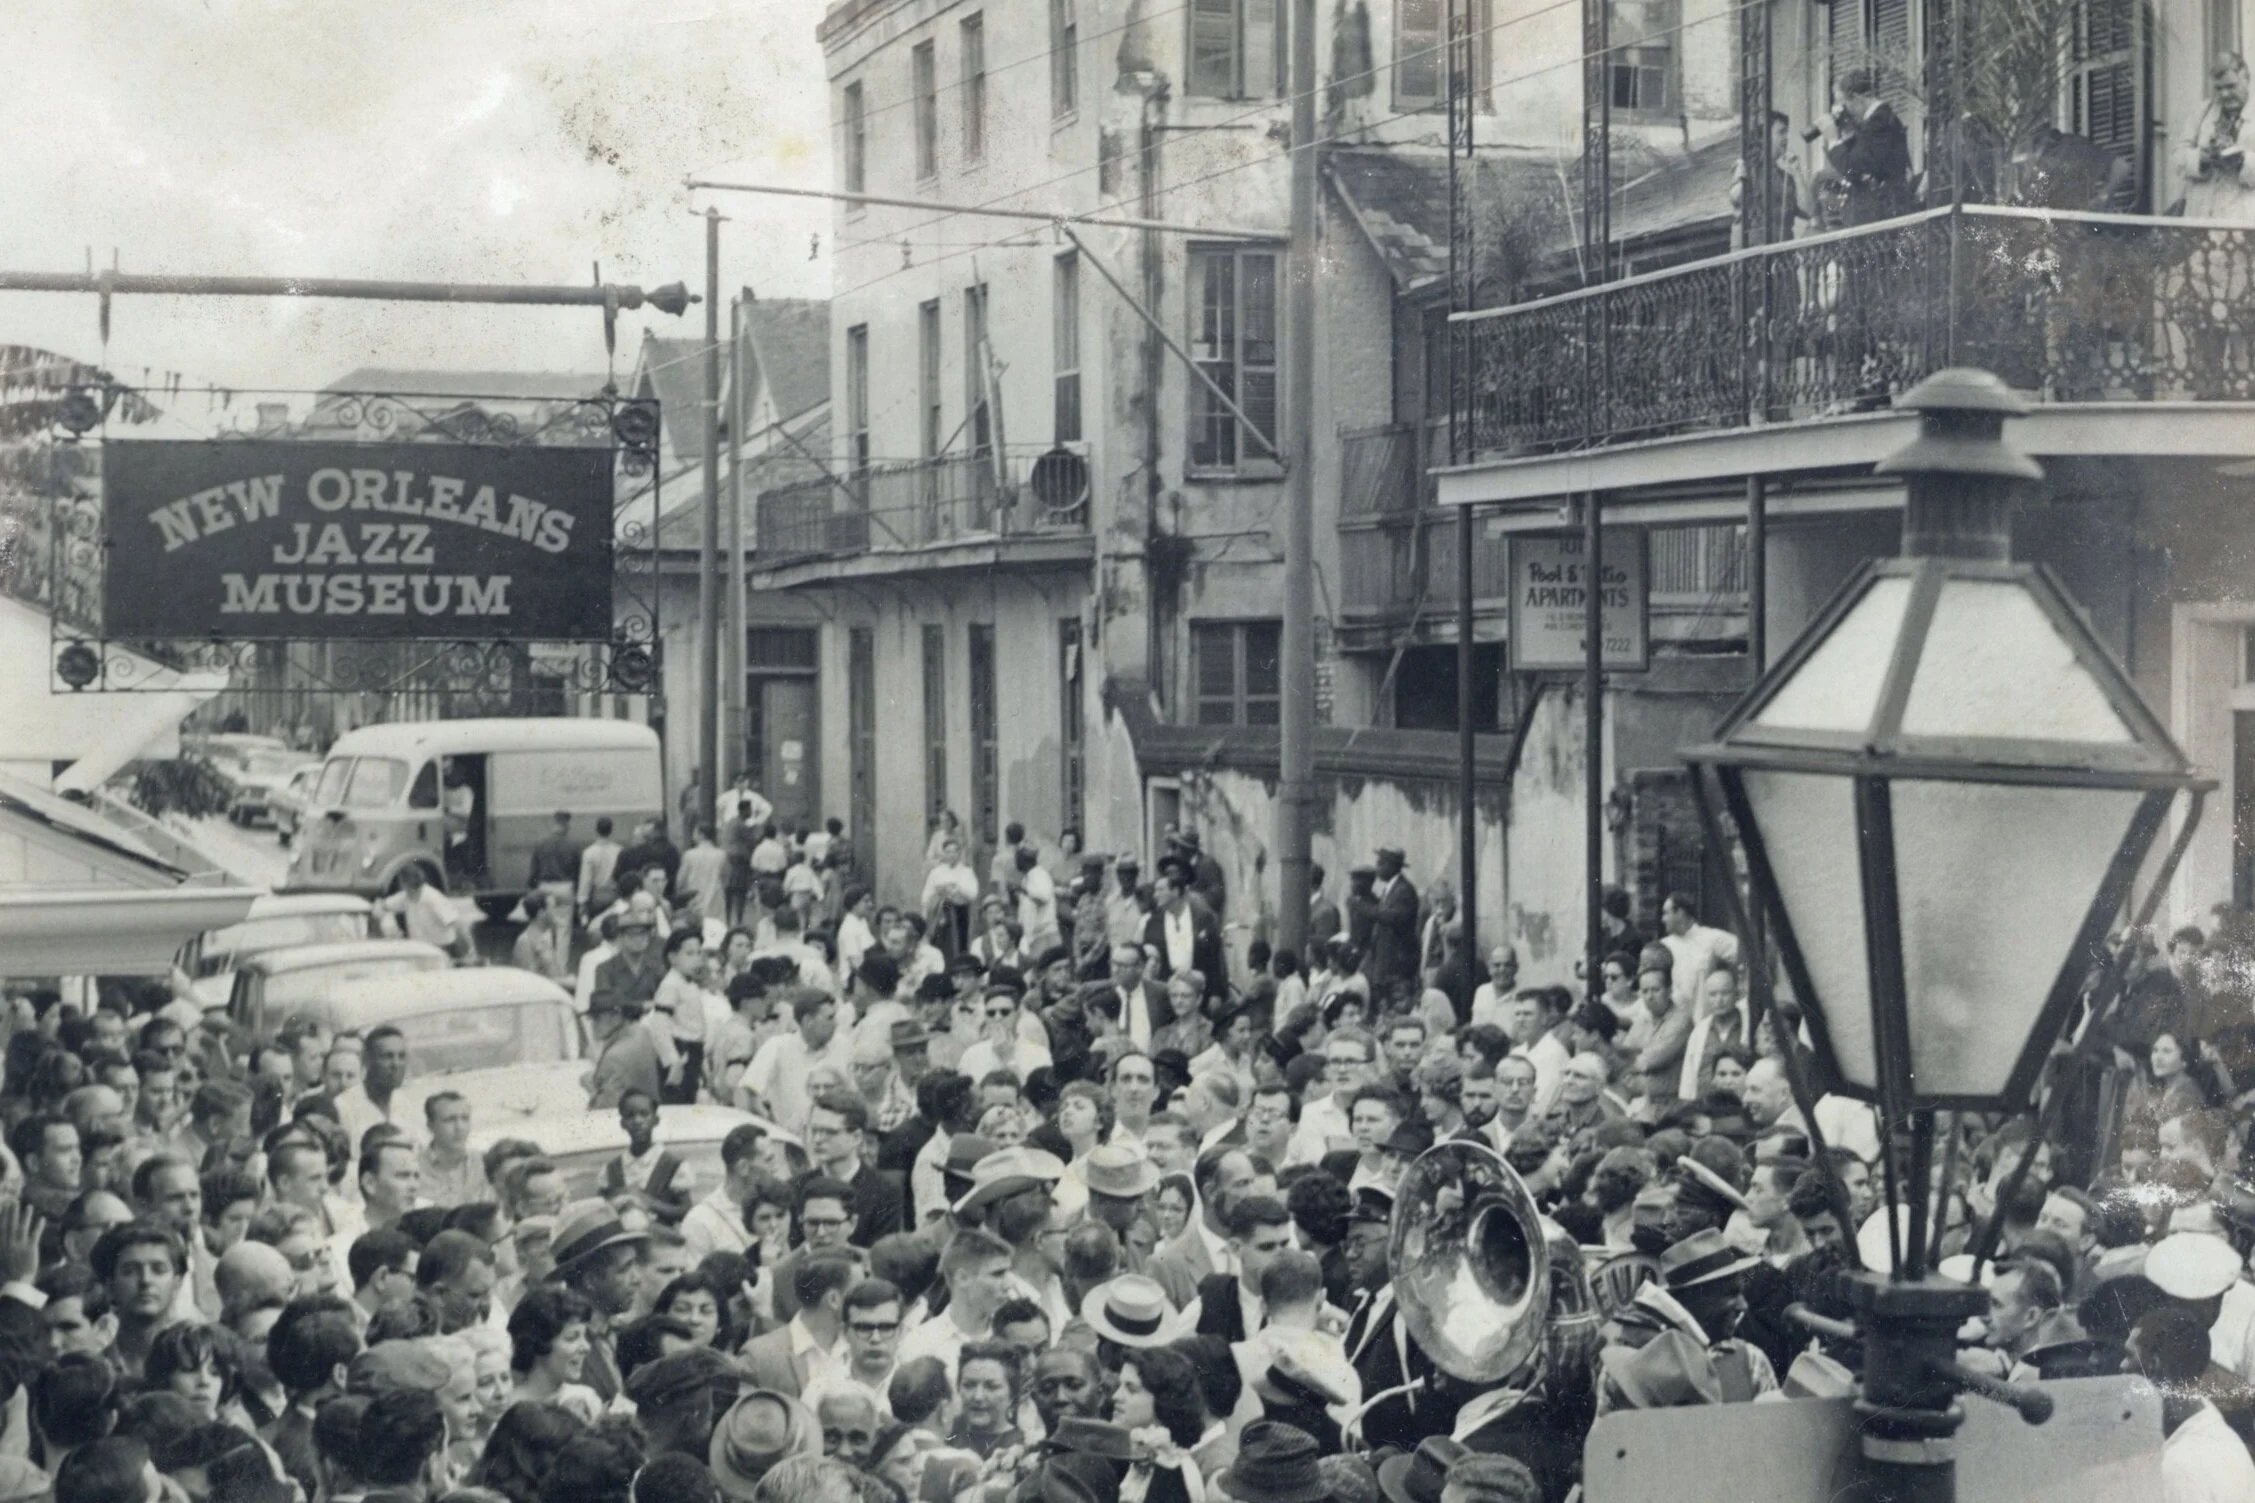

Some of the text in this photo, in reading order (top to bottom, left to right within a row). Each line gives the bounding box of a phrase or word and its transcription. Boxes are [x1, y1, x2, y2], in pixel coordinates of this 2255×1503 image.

[149, 467, 576, 554] NEW ORLEANS
[273, 523, 435, 566] JAZZ
[219, 573, 512, 616] MUSEUM
[1528, 562, 1562, 584] Pool
[1581, 564, 1628, 584] tio
[1526, 586, 1630, 610] APARTMNTS
